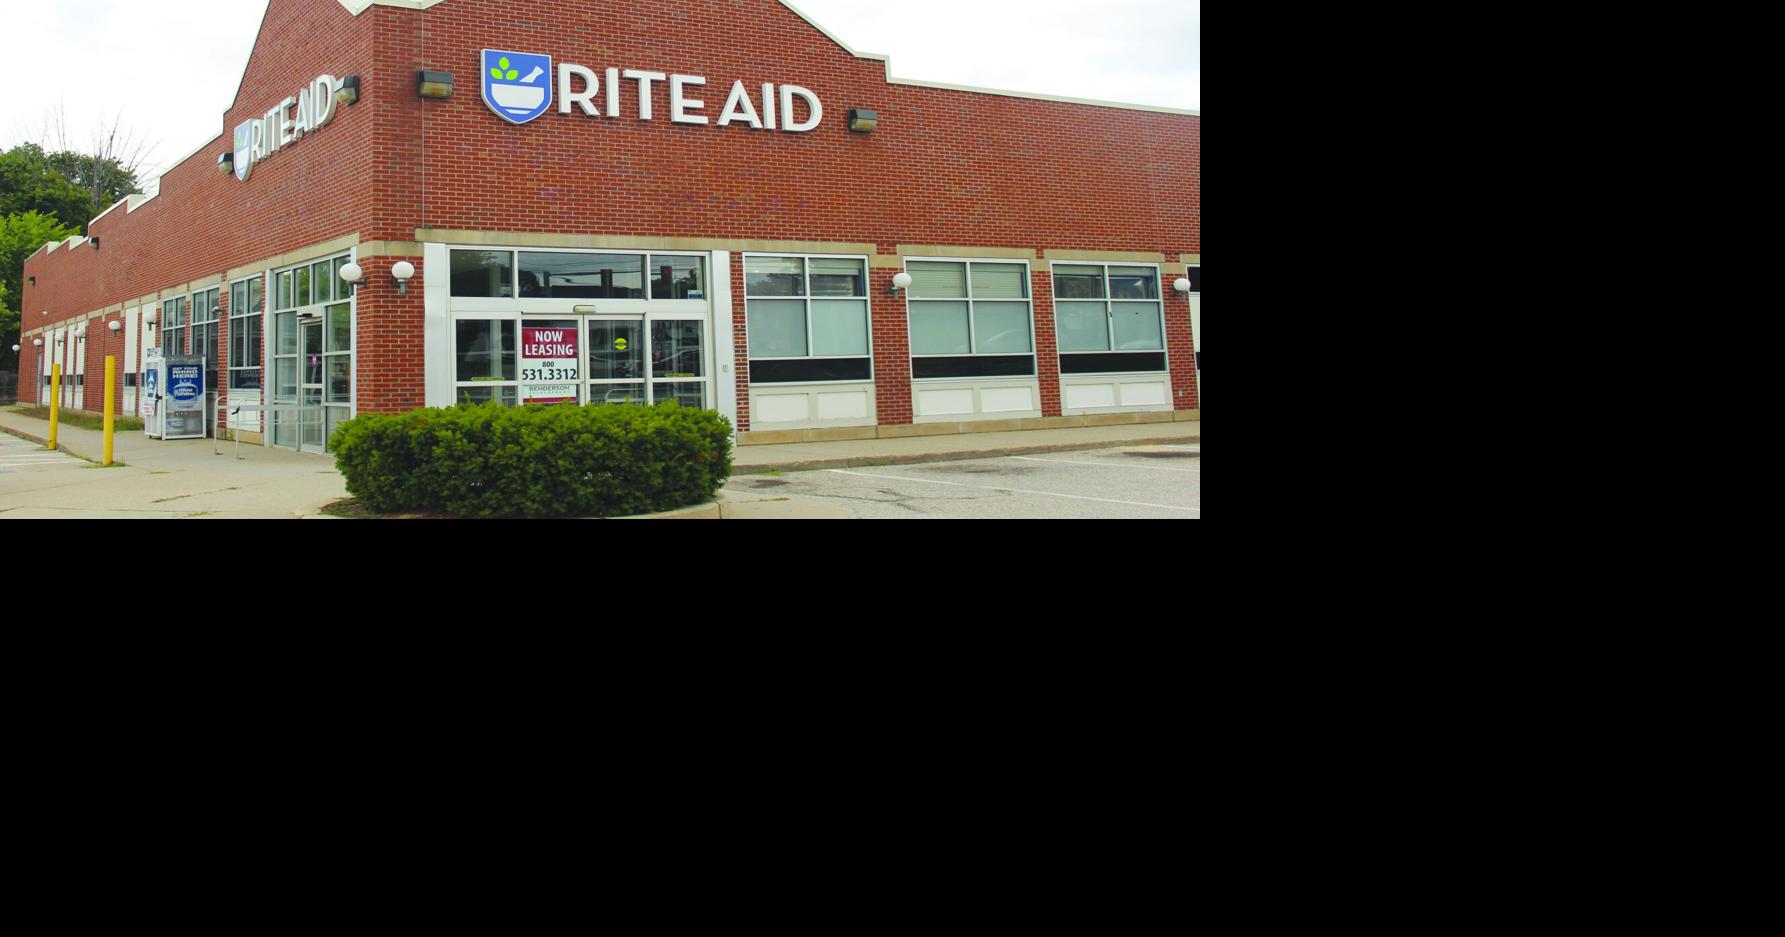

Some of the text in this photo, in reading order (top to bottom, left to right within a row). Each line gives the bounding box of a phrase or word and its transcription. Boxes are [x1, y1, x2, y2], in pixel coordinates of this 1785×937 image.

[557, 62, 823, 132] RITE AID
[251, 74, 337, 163] RITE AID
[535, 331, 563, 342] NOW
[525, 344, 574, 356] LEASING
[522, 369, 577, 380] 531.3312
